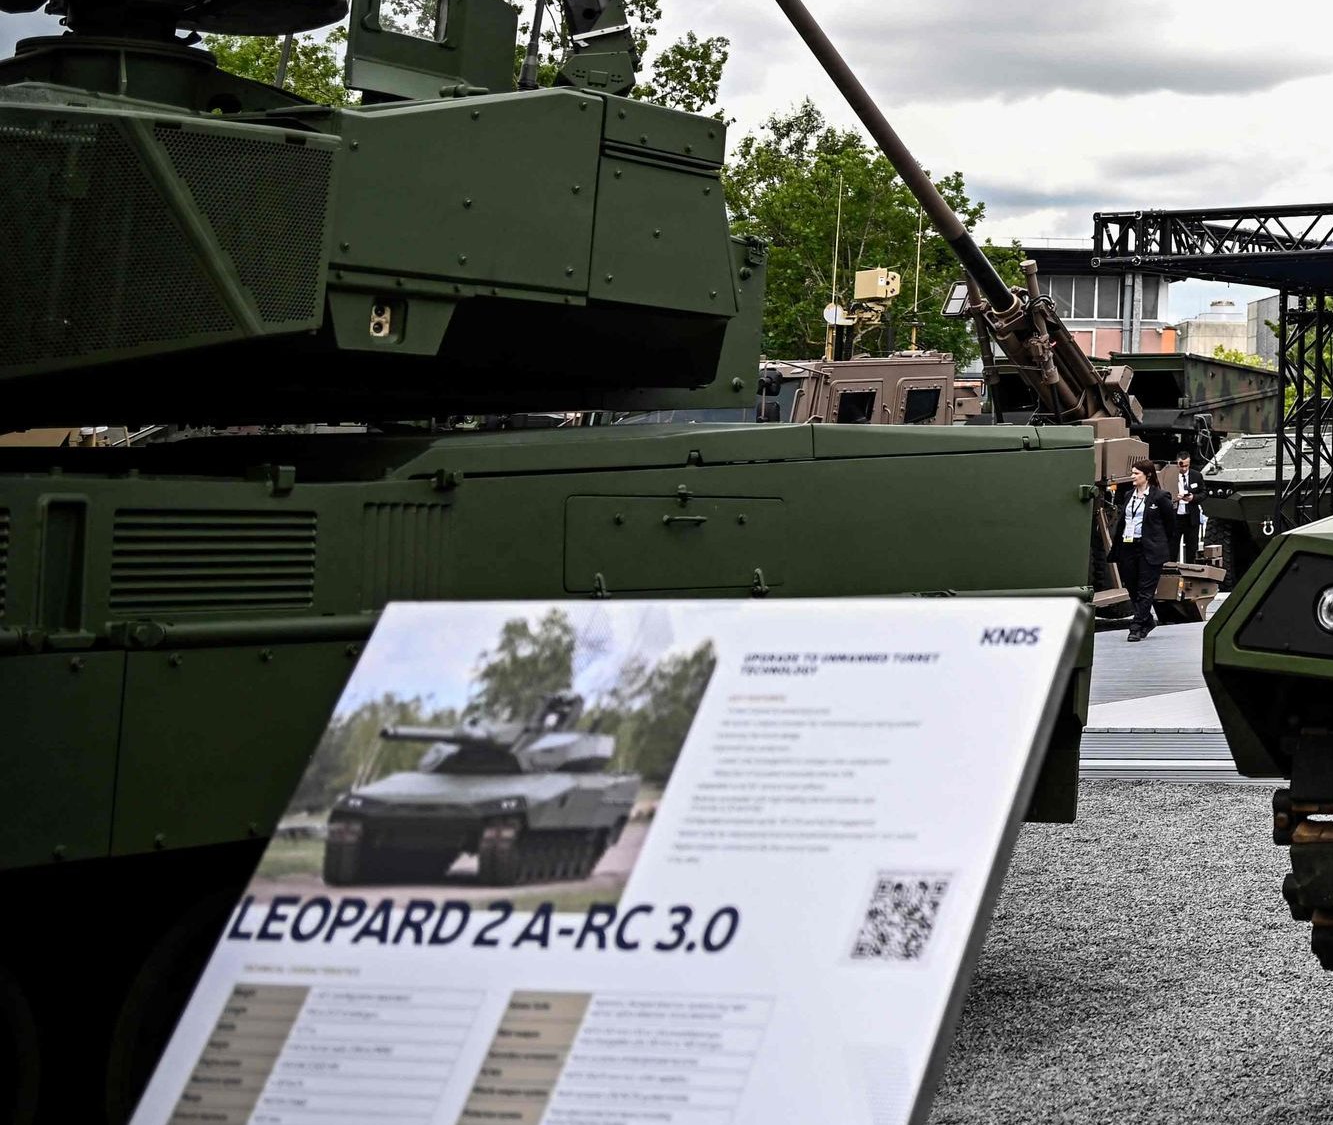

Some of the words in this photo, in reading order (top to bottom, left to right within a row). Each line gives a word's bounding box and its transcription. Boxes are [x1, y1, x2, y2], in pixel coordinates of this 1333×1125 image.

[980, 627, 1041, 646] KNDS
[227, 895, 471, 946] LEOPARD
[472, 903, 510, 948] 2
[511, 902, 652, 951] A-RC
[654, 905, 740, 953] 3.0
